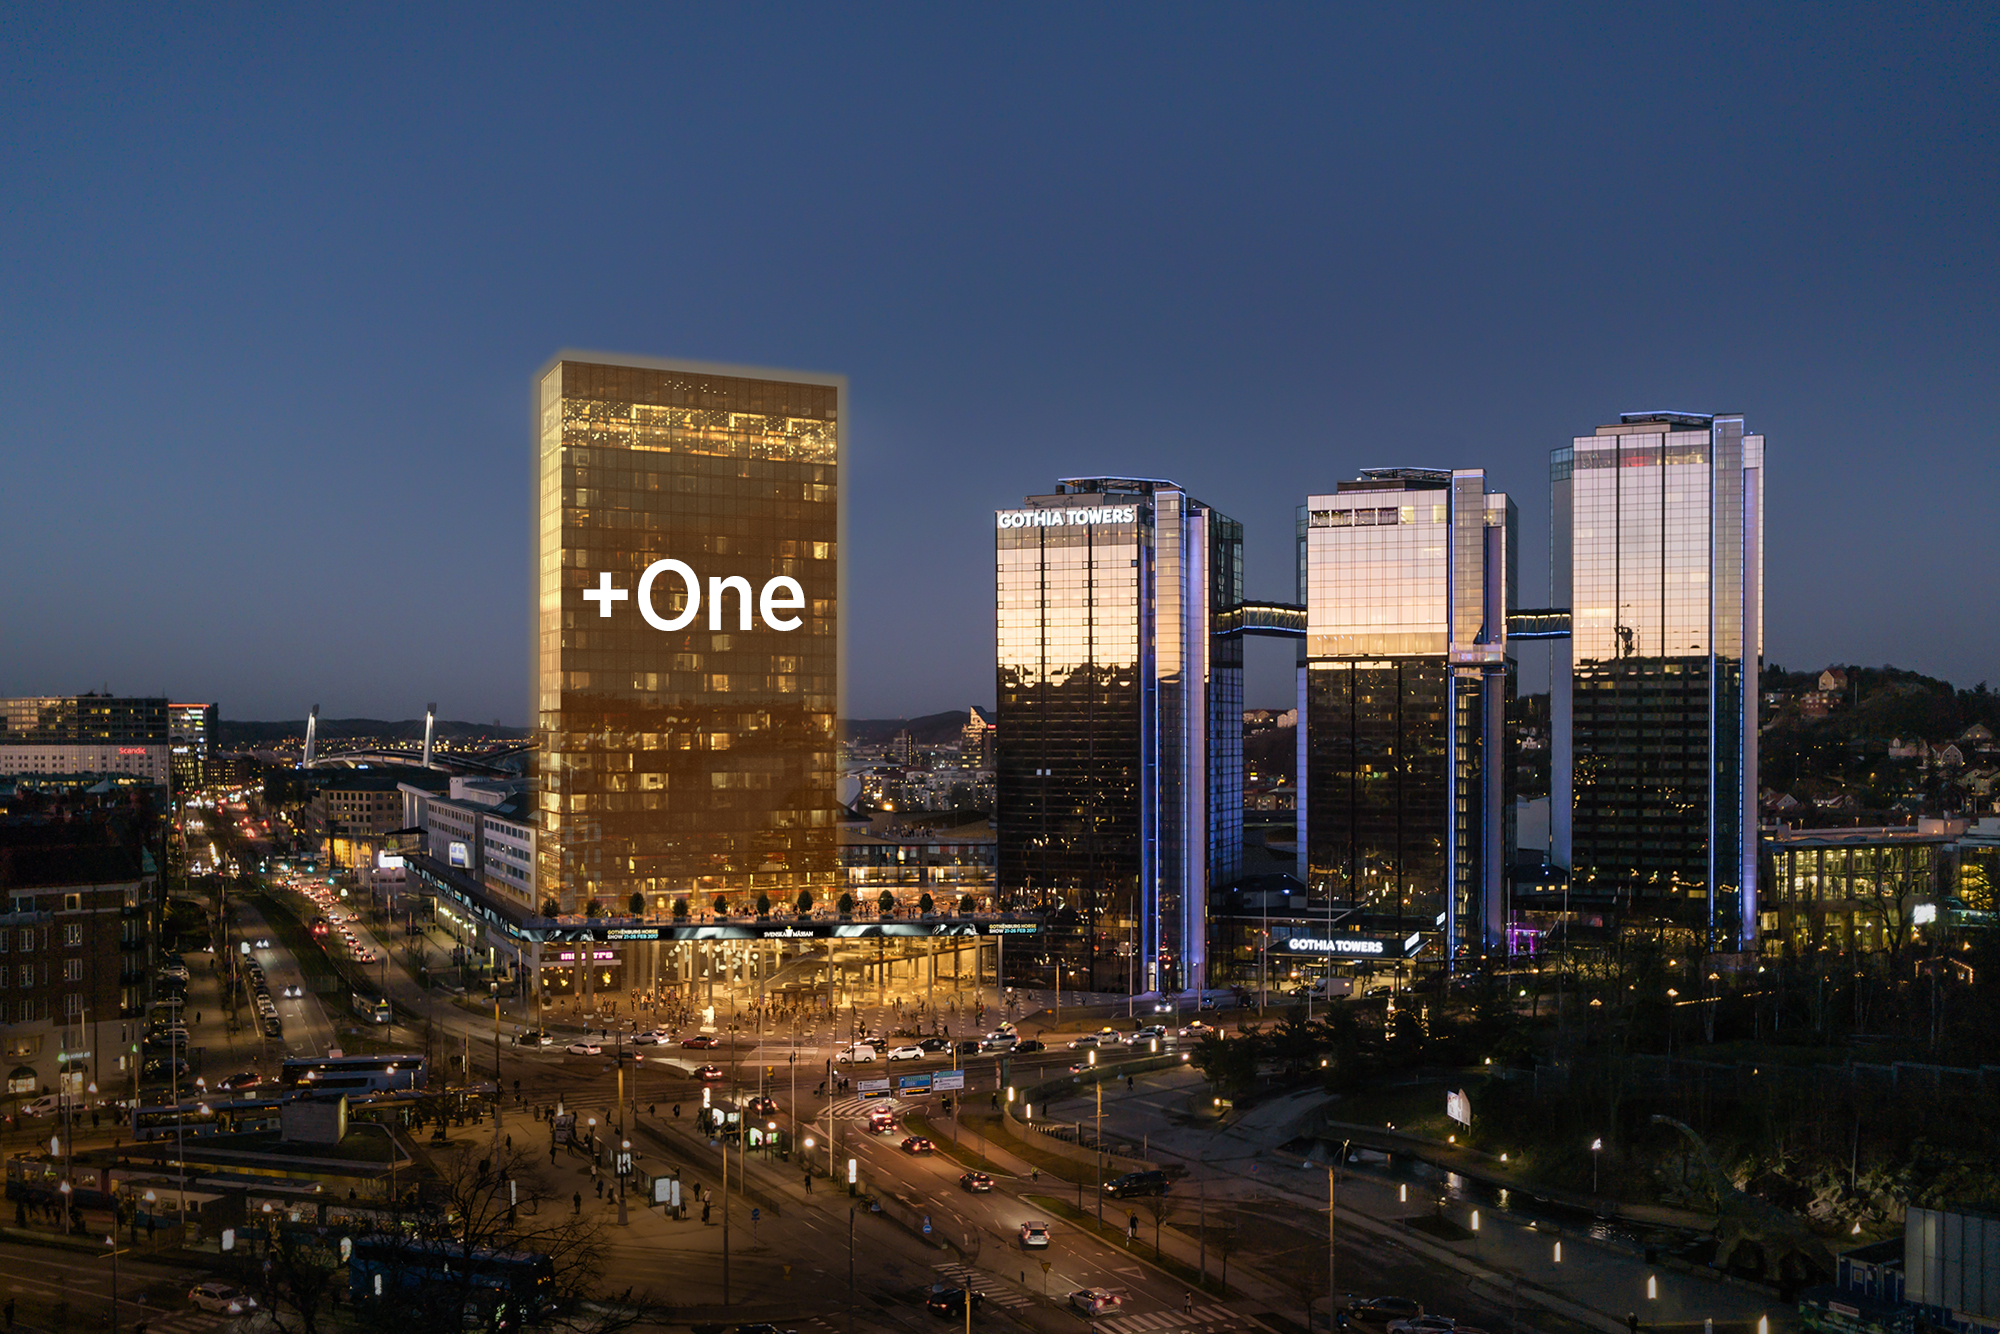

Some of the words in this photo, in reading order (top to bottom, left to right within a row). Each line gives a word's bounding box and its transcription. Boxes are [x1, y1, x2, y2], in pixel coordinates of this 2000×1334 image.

[998, 511, 1065, 529] GOTHIA
[1066, 508, 1135, 526] TOWERS
[119, 746, 147, 755] Scandic
[1289, 938, 1335, 951] GOTHIA
[1335, 940, 1384, 953] TOWERS
